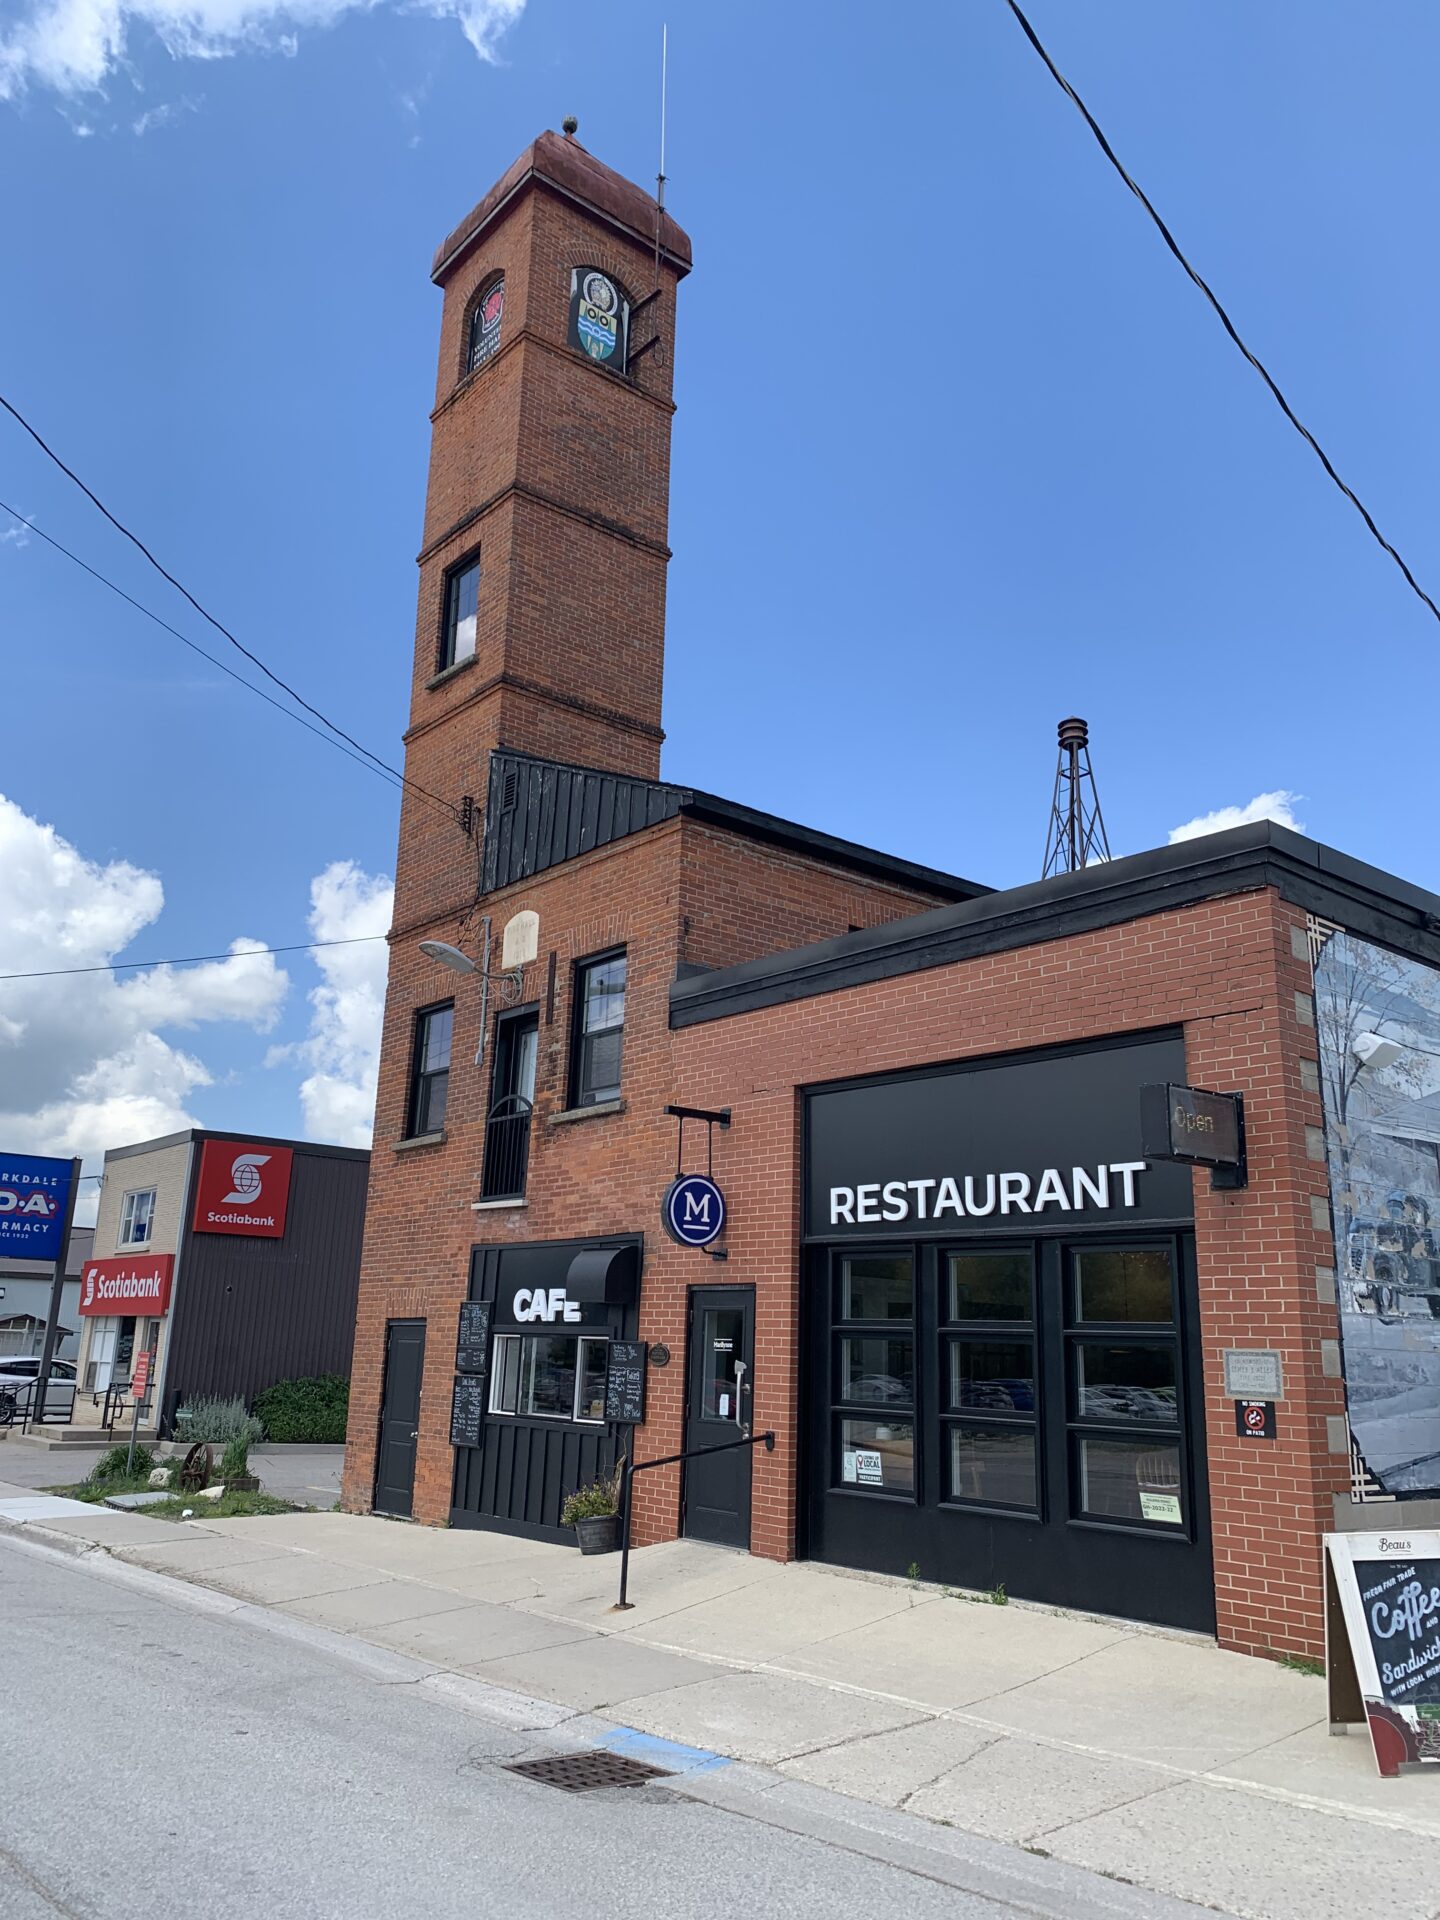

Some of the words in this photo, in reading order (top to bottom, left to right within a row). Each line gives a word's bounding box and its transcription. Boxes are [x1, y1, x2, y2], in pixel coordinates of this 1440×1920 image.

[1174, 1106, 1214, 1133] Open
[830, 1161, 1146, 1225] RESTAURANT
[207, 1211, 275, 1227] Scotiabank
[683, 1191, 712, 1223] M
[97, 1270, 161, 1299] Scotiabank
[864, 1460, 880, 1468] LOCAL
[1379, 1538, 1412, 1552] Beau's
[1362, 1585, 1384, 1602] FRESH
[1383, 1577, 1397, 1592] FAIR
[1396, 1566, 1417, 1582] TRADE
[1371, 1581, 1440, 1640] Coffee
[1426, 1616, 1439, 1628] AND
[1390, 1682, 1407, 1697] WITH
[1406, 1674, 1425, 1689] LOCAL
